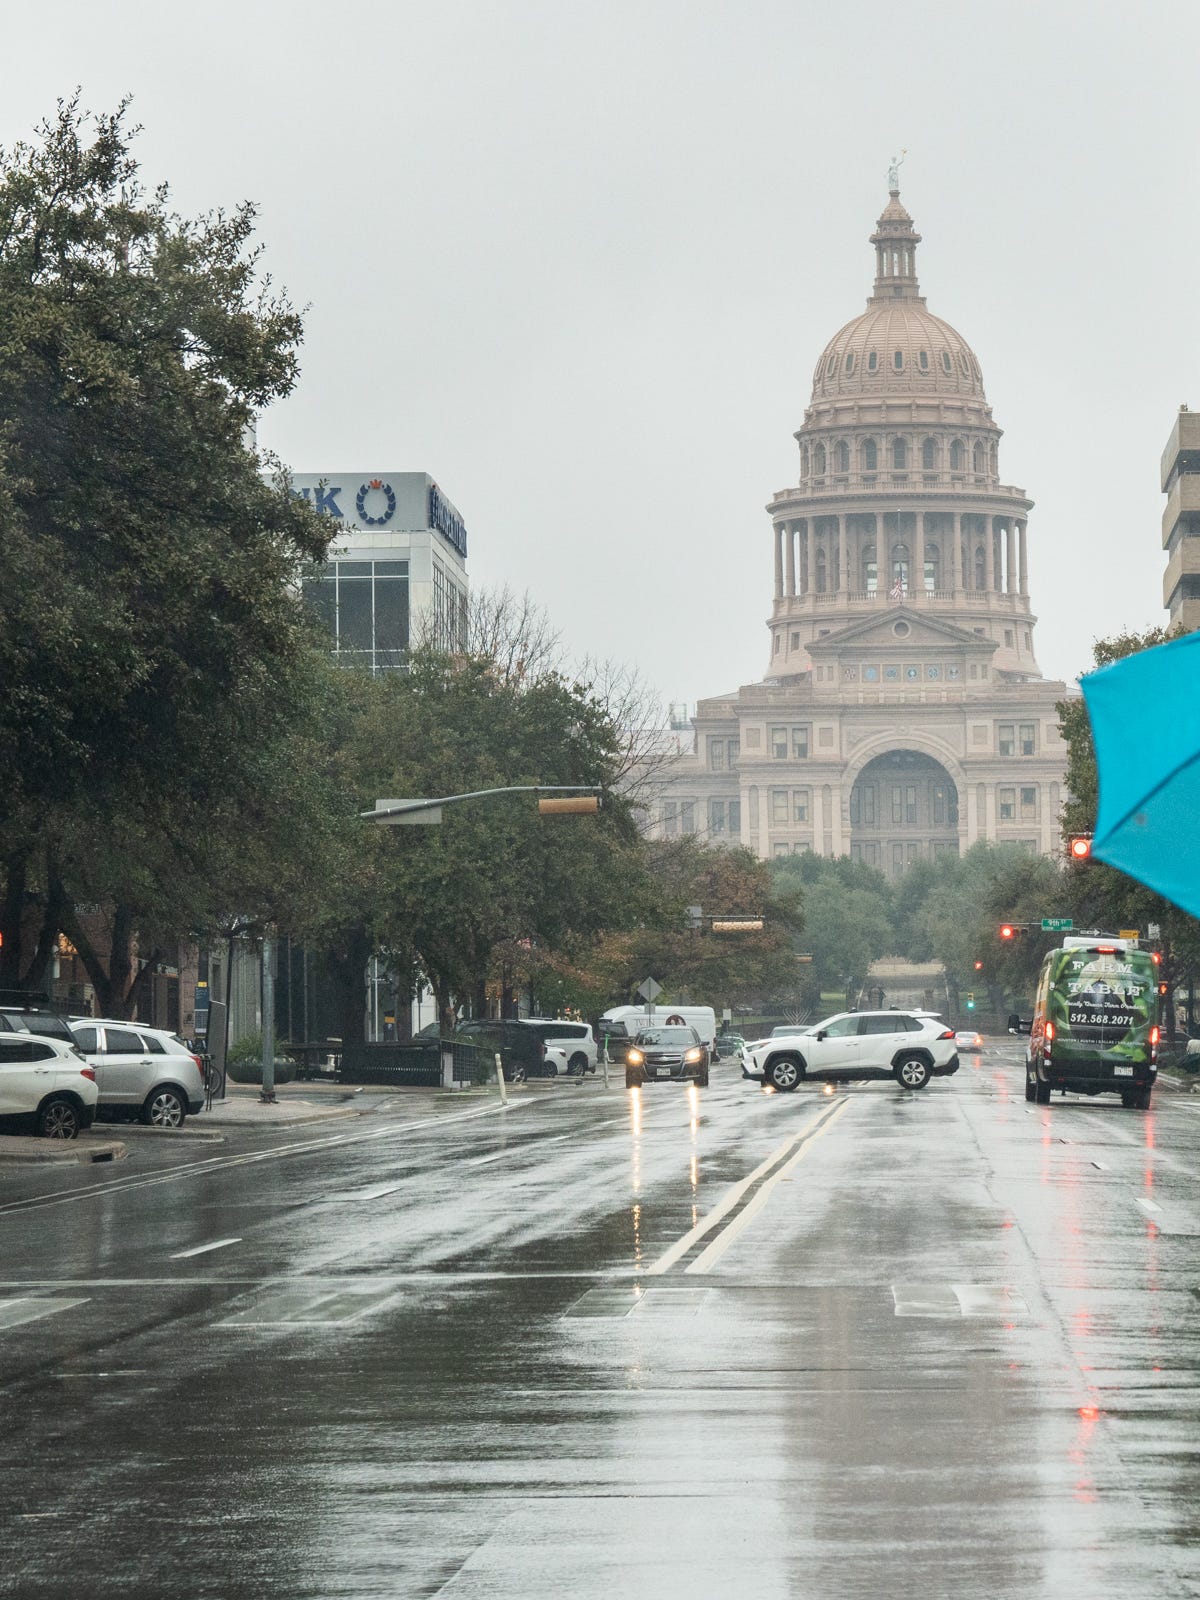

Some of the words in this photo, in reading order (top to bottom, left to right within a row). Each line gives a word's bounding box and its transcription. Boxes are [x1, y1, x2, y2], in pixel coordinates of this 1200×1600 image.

[1072, 961, 1133, 974] FARM
[1068, 982, 1141, 996] TABLE
[1070, 1013, 1134, 1025] 512.568.2071
